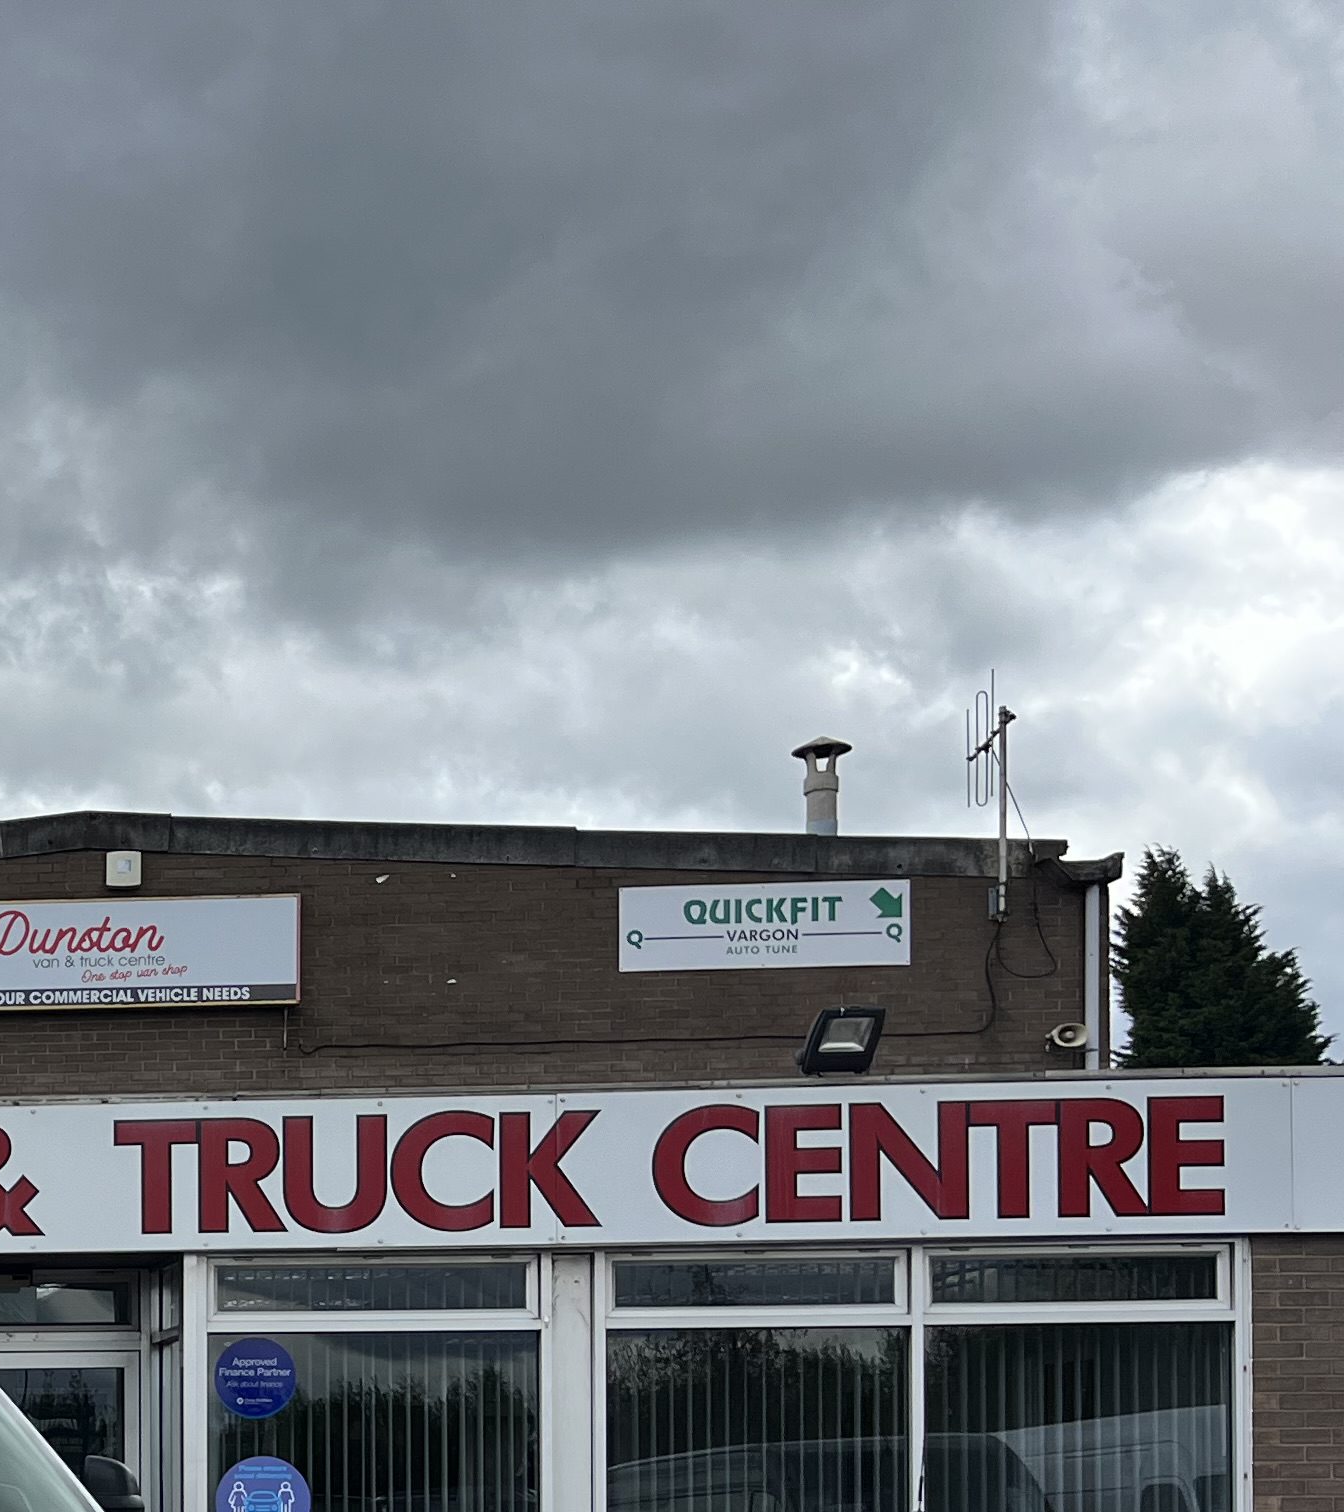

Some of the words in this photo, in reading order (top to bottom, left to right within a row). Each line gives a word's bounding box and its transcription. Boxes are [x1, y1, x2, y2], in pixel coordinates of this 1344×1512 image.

[683, 896, 843, 925] QUICKFIT
[626, 929, 643, 949] Q
[726, 928, 799, 942] VARGON
[885, 923, 903, 943] Q
[726, 945, 760, 955] AUTO
[765, 944, 798, 954] TUNE
[32, 957, 60, 968] van
[64, 955, 75, 968] &
[79, 954, 113, 967] truck
[118, 954, 166, 967] centre
[81, 969, 106, 983] One
[109, 968, 132, 982] stop
[136, 967, 159, 978] van
[162, 964, 188, 976] shop
[28, 989, 135, 1004] COMMERCIAL
[137, 988, 199, 1003] VEHICLE
[202, 986, 251, 1001] NEEDS
[113, 1109, 603, 1236] TRUCK
[652, 1095, 1226, 1228] CENTRE
[218, 1367, 255, 1376] Finance
[256, 1367, 292, 1376] Partner
[232, 1357, 278, 1368] Approved
